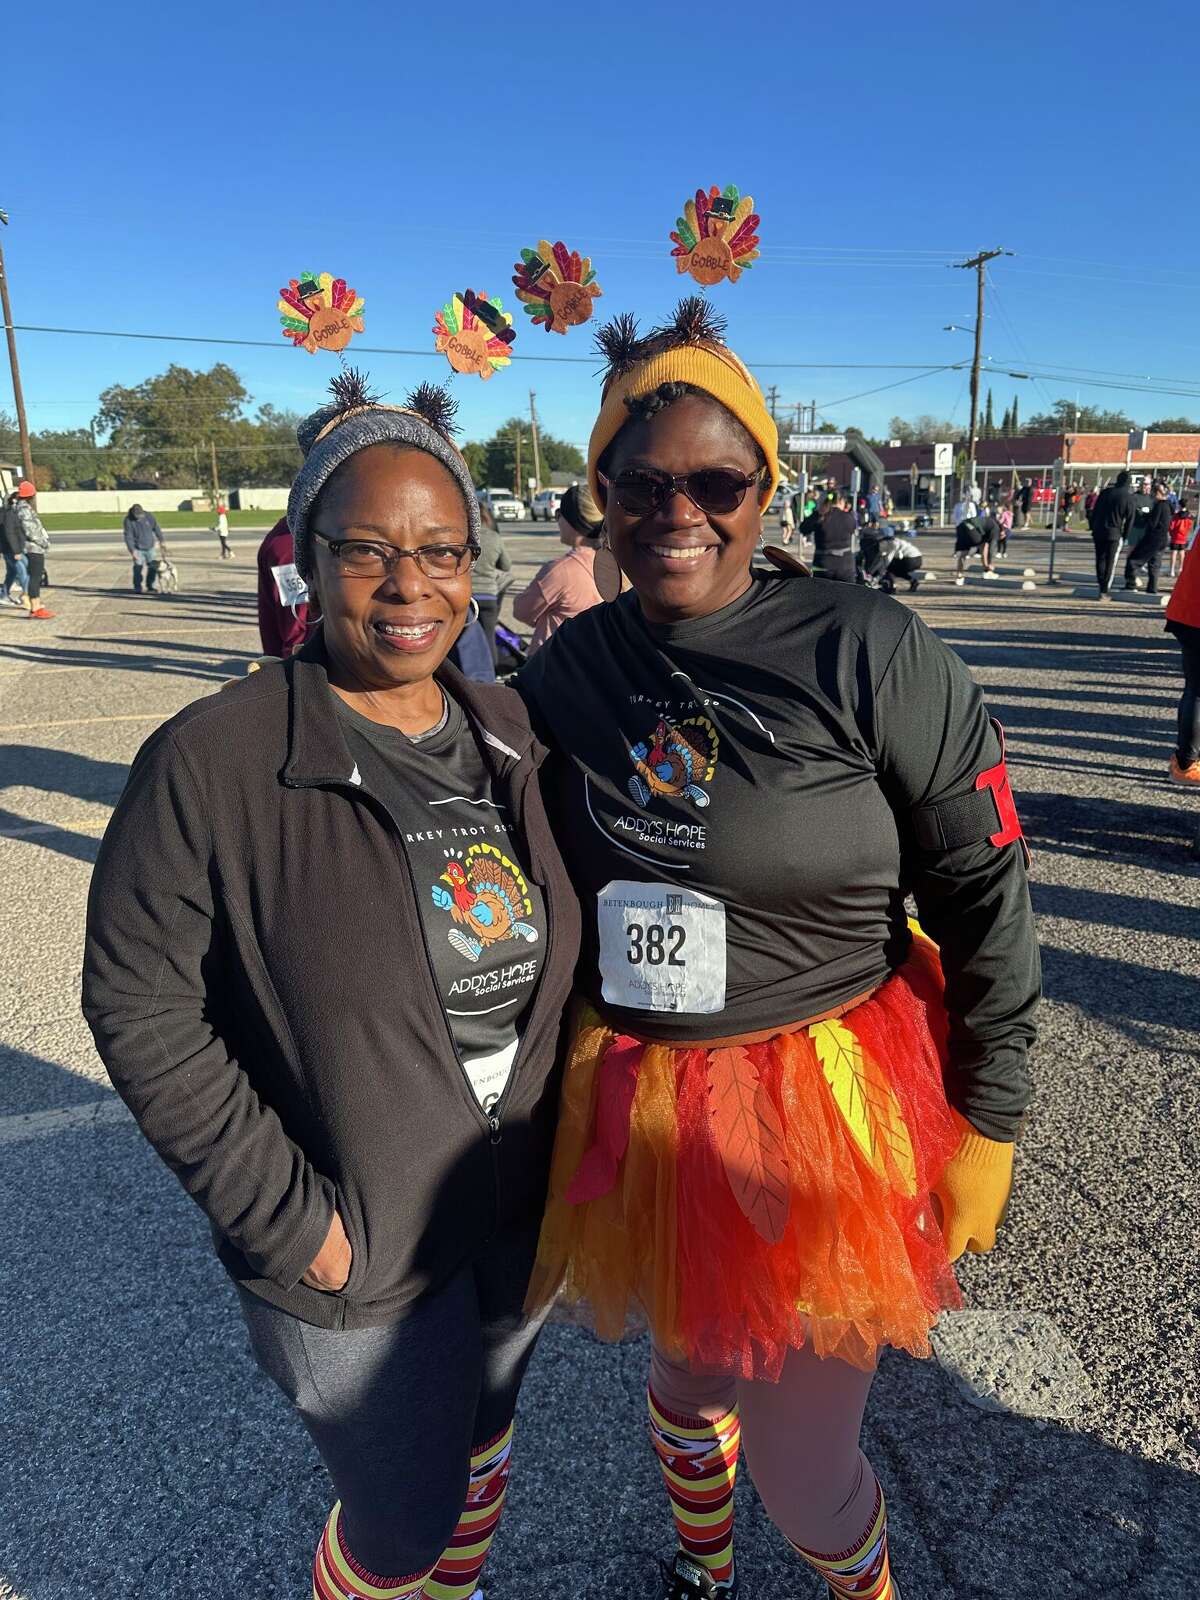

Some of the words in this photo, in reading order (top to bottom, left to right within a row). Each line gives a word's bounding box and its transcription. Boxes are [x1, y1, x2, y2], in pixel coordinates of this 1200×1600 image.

[691, 253, 729, 271] GOBBLE
[313, 318, 350, 342] GOBBLE
[448, 336, 483, 365] GOBBLE
[406, 829, 443, 843] RKEY
[451, 826, 486, 837] TROT
[613, 815, 662, 835] ADDY'S
[666, 822, 706, 841] HOPE
[638, 832, 666, 844] Social
[668, 838, 706, 850] Services
[603, 899, 663, 909] BETENBOUGH
[626, 923, 687, 967] 382
[448, 971, 499, 996] ADDY'S
[501, 960, 537, 982] HOPE
[475, 982, 501, 996] Social
[502, 974, 534, 989] Services
